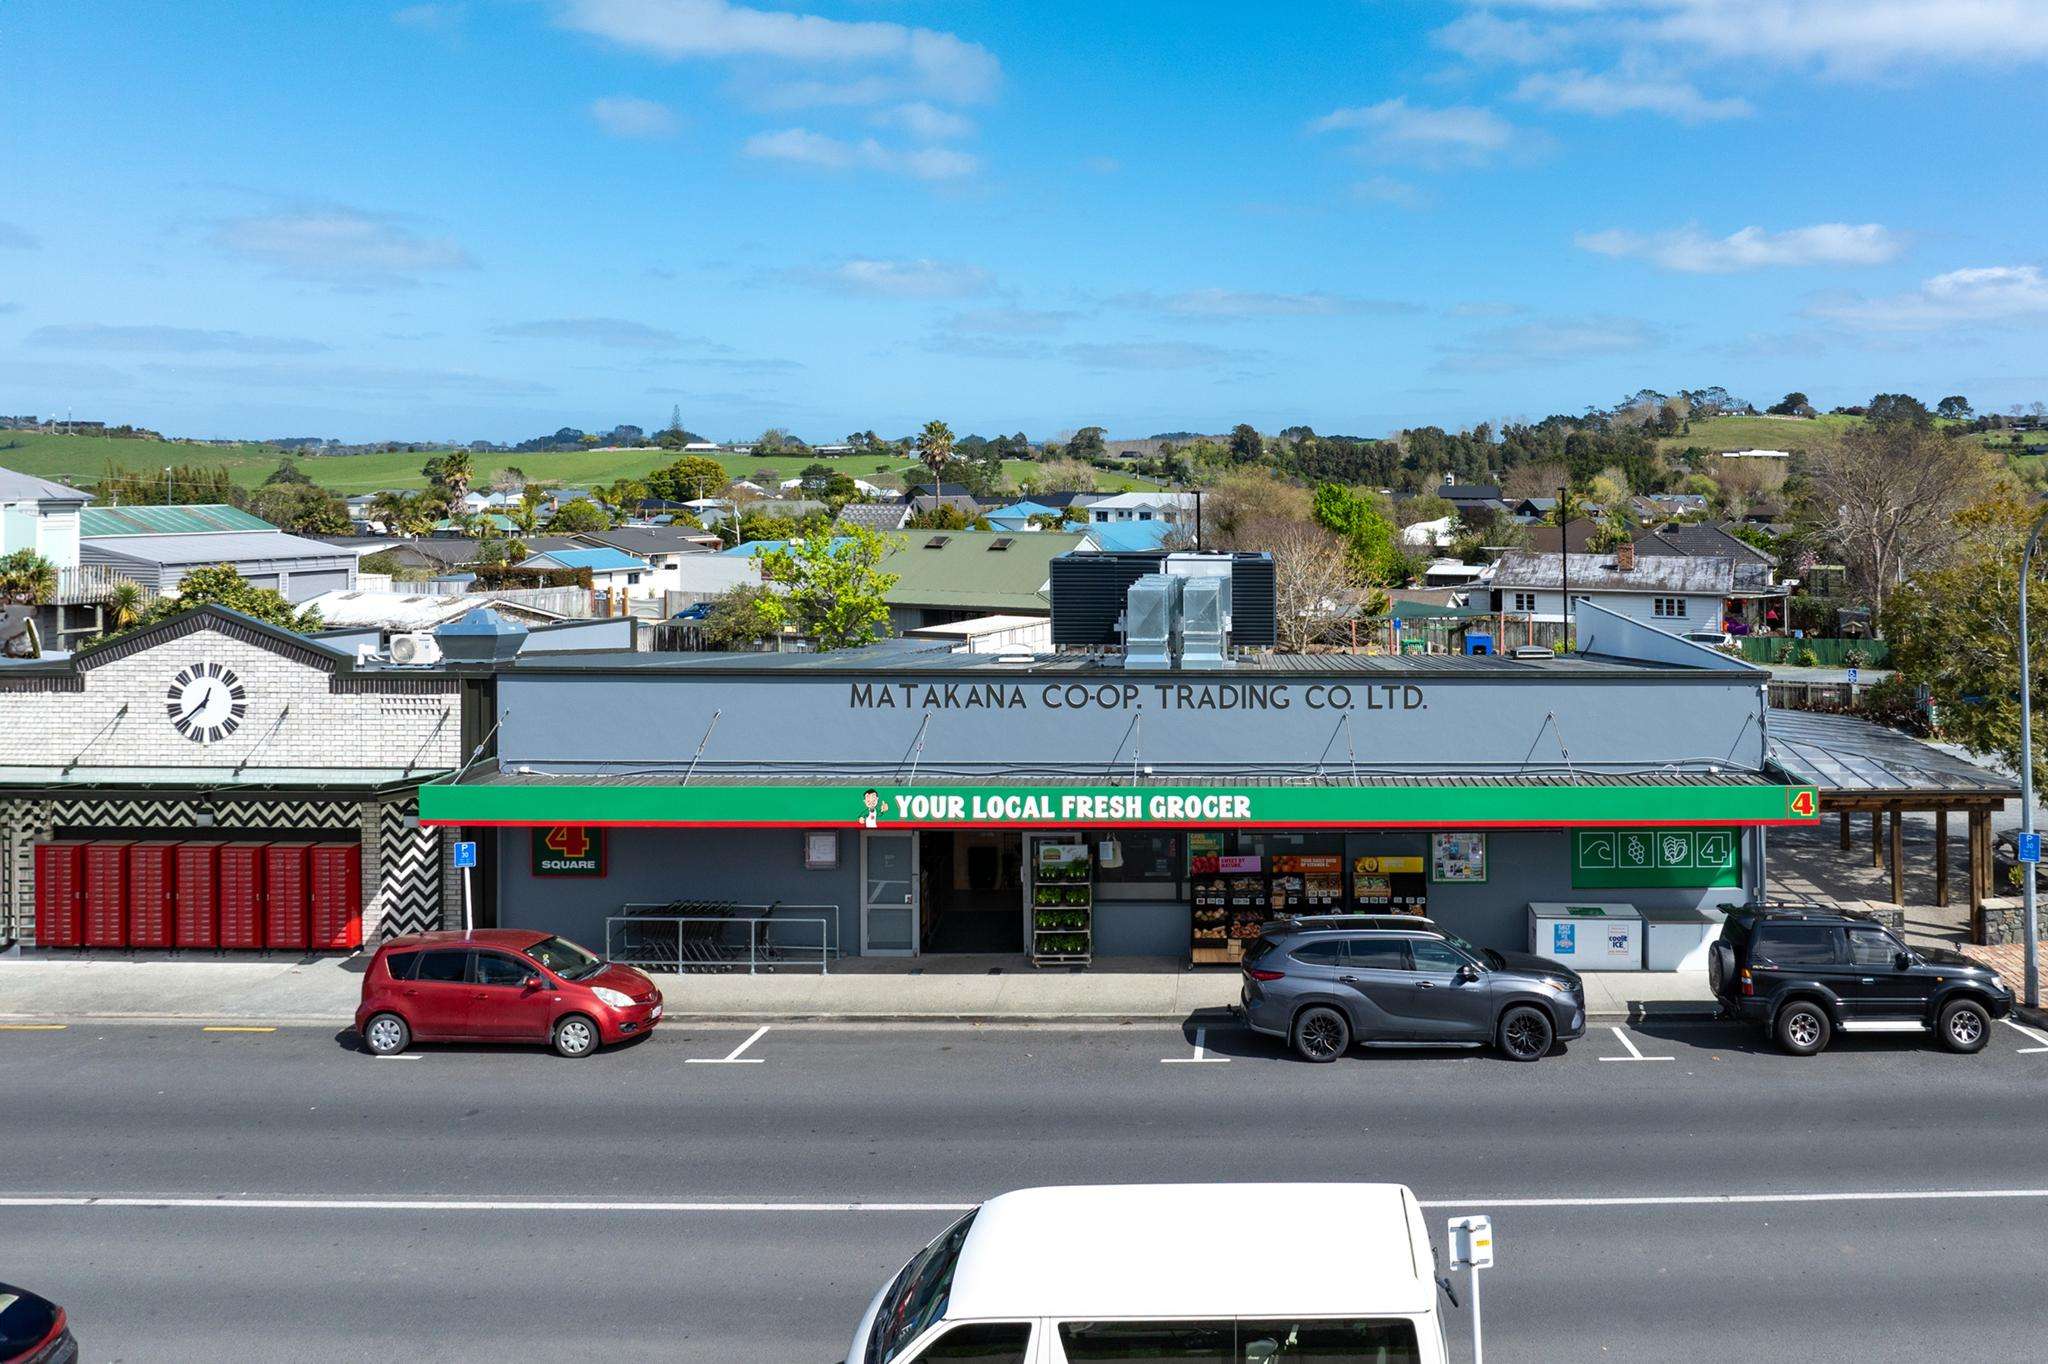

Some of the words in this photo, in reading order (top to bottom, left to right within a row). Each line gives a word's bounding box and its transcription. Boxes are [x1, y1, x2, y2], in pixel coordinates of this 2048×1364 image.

[850, 683, 1027, 708] MATAKANA
[1042, 684, 1142, 709] CO-OP.
[1155, 684, 1290, 709] TRADING
[1305, 685, 1354, 709] CO.
[1367, 685, 1428, 709] LTD.
[895, 795, 965, 819] YOUR
[972, 795, 1056, 819] LOCAL
[1062, 795, 1142, 819] FRESH
[1149, 795, 1252, 819] GROCER
[1791, 791, 1815, 816] 4
[461, 844, 469, 852] P
[545, 827, 590, 857] 4
[1700, 836, 1728, 863] 4
[541, 860, 595, 869] SQUARE
